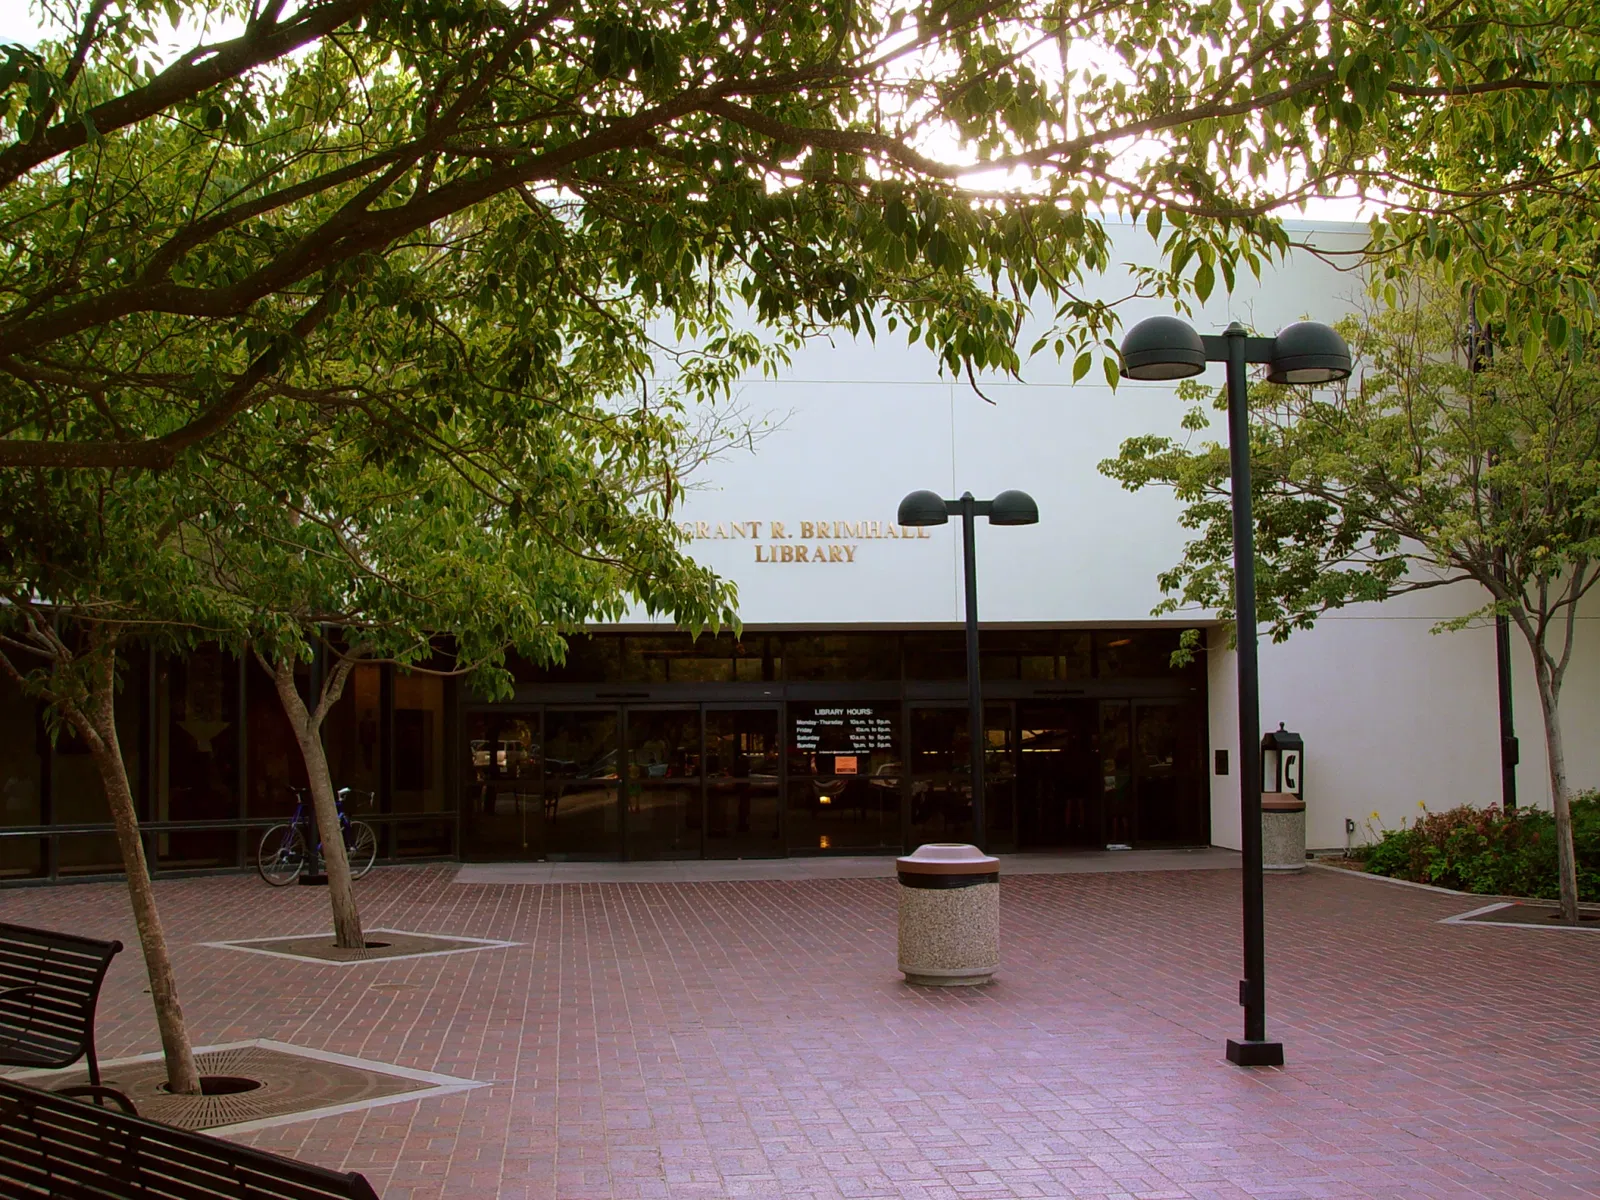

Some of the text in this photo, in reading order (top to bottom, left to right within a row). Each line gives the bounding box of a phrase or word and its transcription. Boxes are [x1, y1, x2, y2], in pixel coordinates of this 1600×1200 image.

[682, 520, 931, 539] GRANT R. BRIMHALL
[754, 544, 858, 563] LIBRARY
[814, 708, 844, 716] LIBRARY
